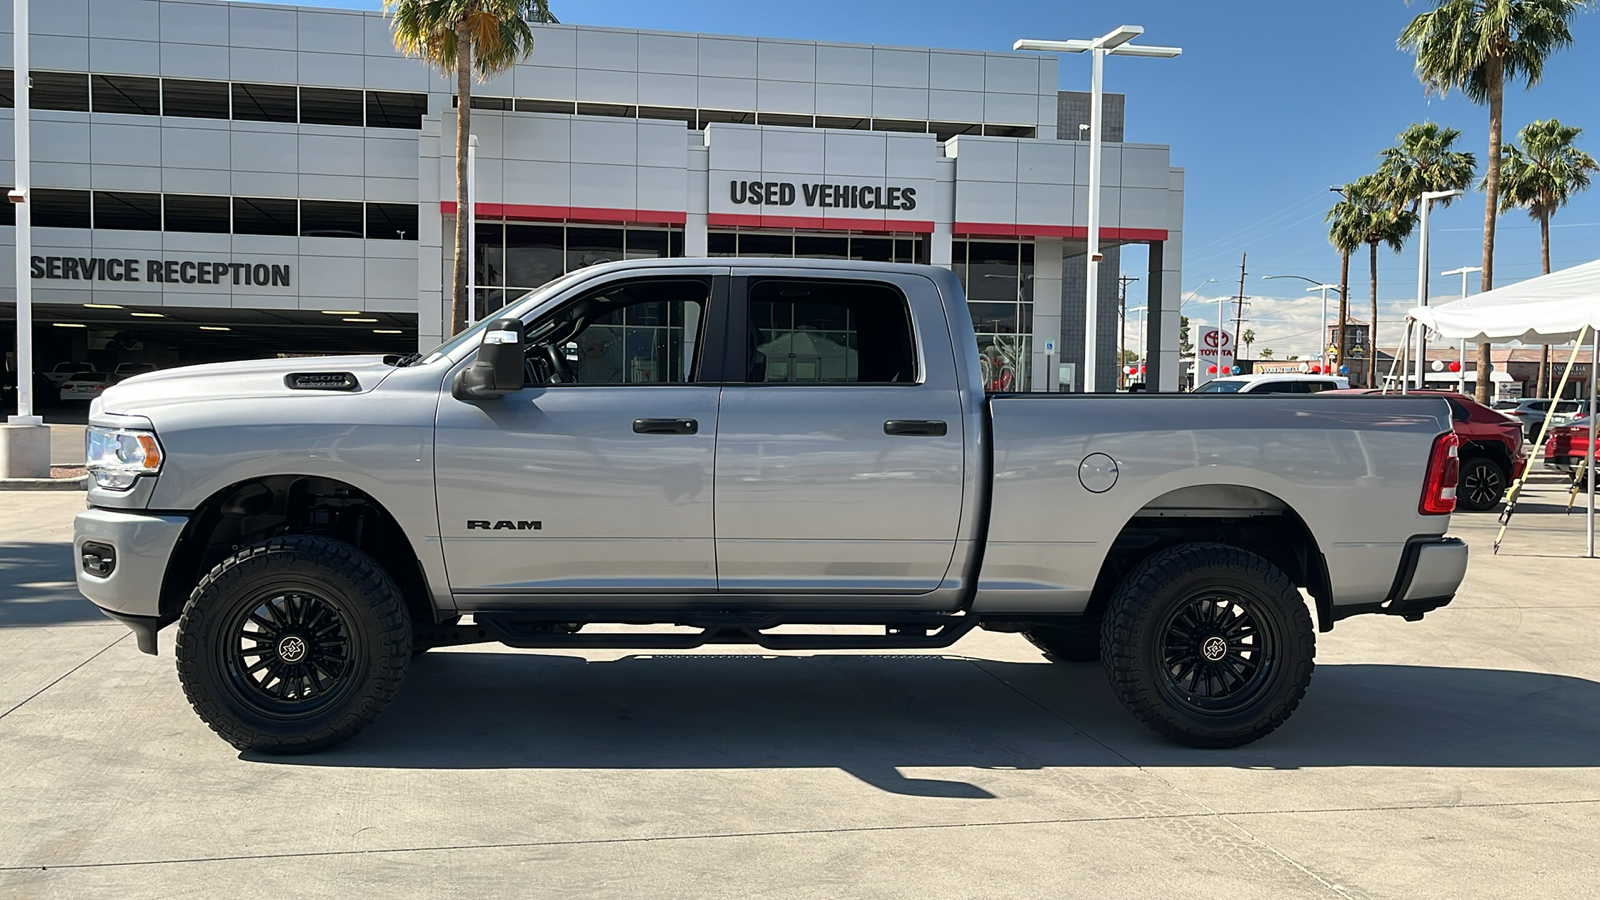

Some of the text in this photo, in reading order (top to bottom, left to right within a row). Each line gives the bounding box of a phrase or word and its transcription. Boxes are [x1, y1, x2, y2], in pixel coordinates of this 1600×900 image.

[730, 180, 917, 211] USED VEHICLES
[30, 255, 290, 287] SERVICE RECEPTION
[466, 520, 542, 530] RAM
